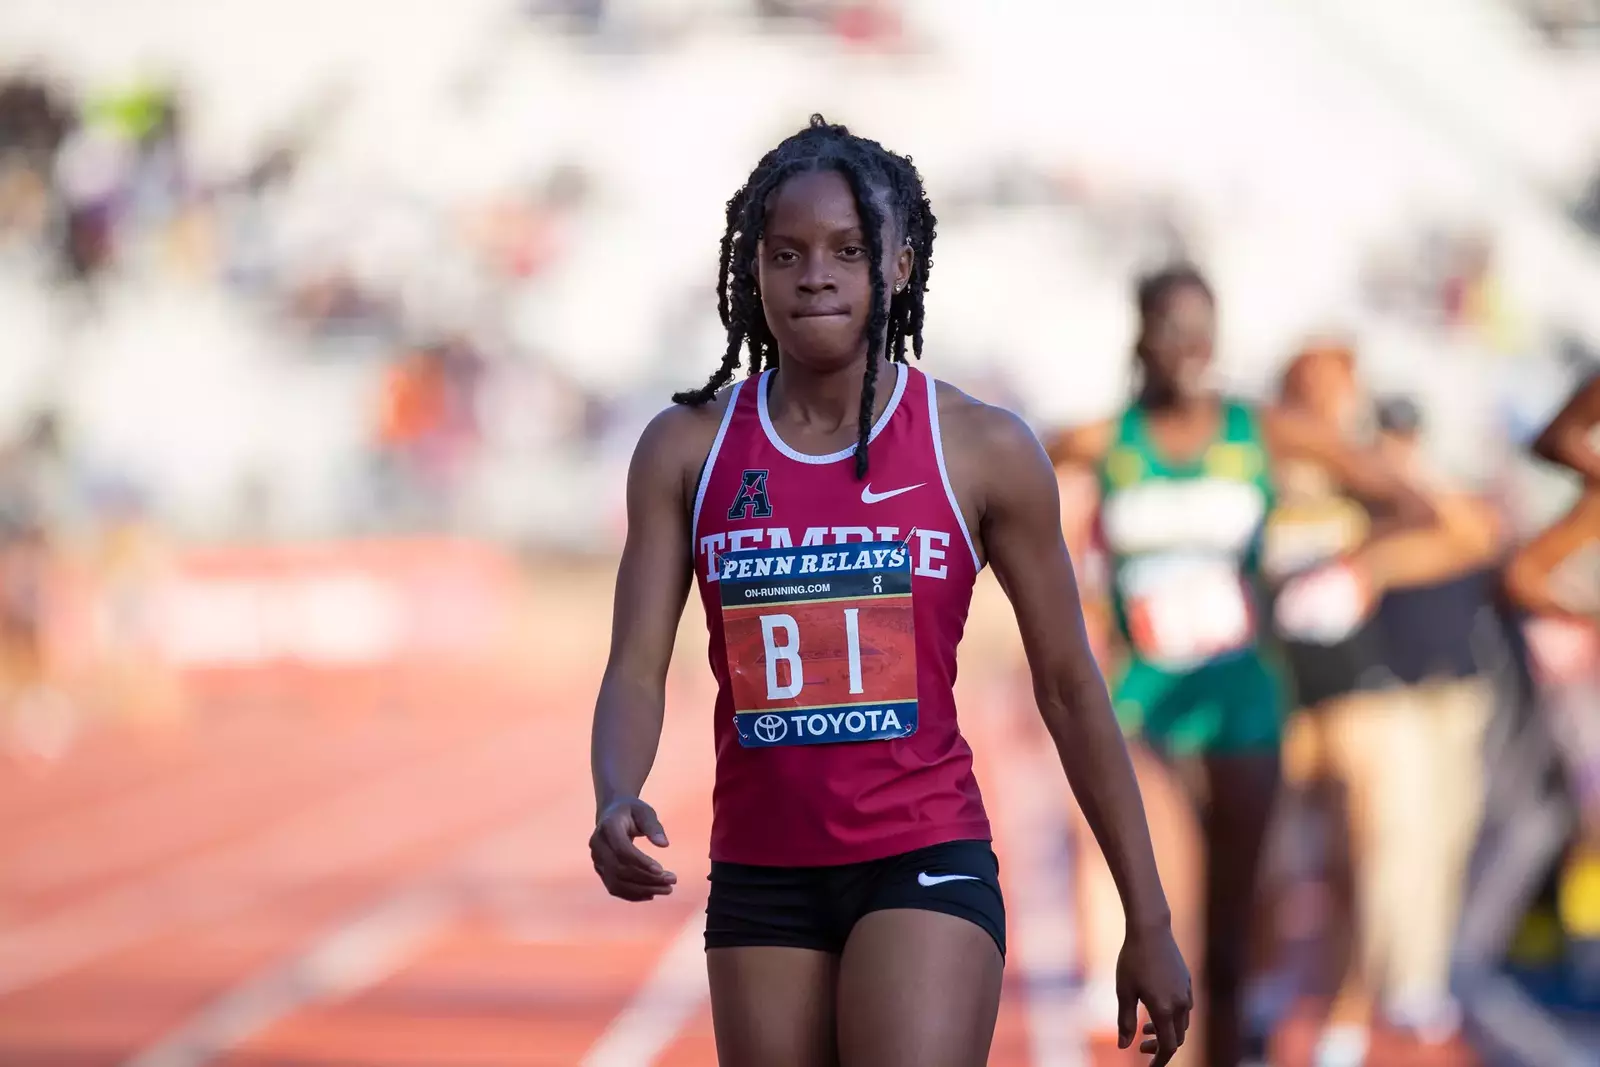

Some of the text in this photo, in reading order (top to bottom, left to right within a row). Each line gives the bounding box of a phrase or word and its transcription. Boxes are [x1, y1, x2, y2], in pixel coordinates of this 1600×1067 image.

[721, 548, 907, 579] PENN RELAYS
[744, 584, 831, 598] ON-RUNNING.COM
[759, 614, 804, 700] B
[791, 709, 901, 736] TOYOTA
